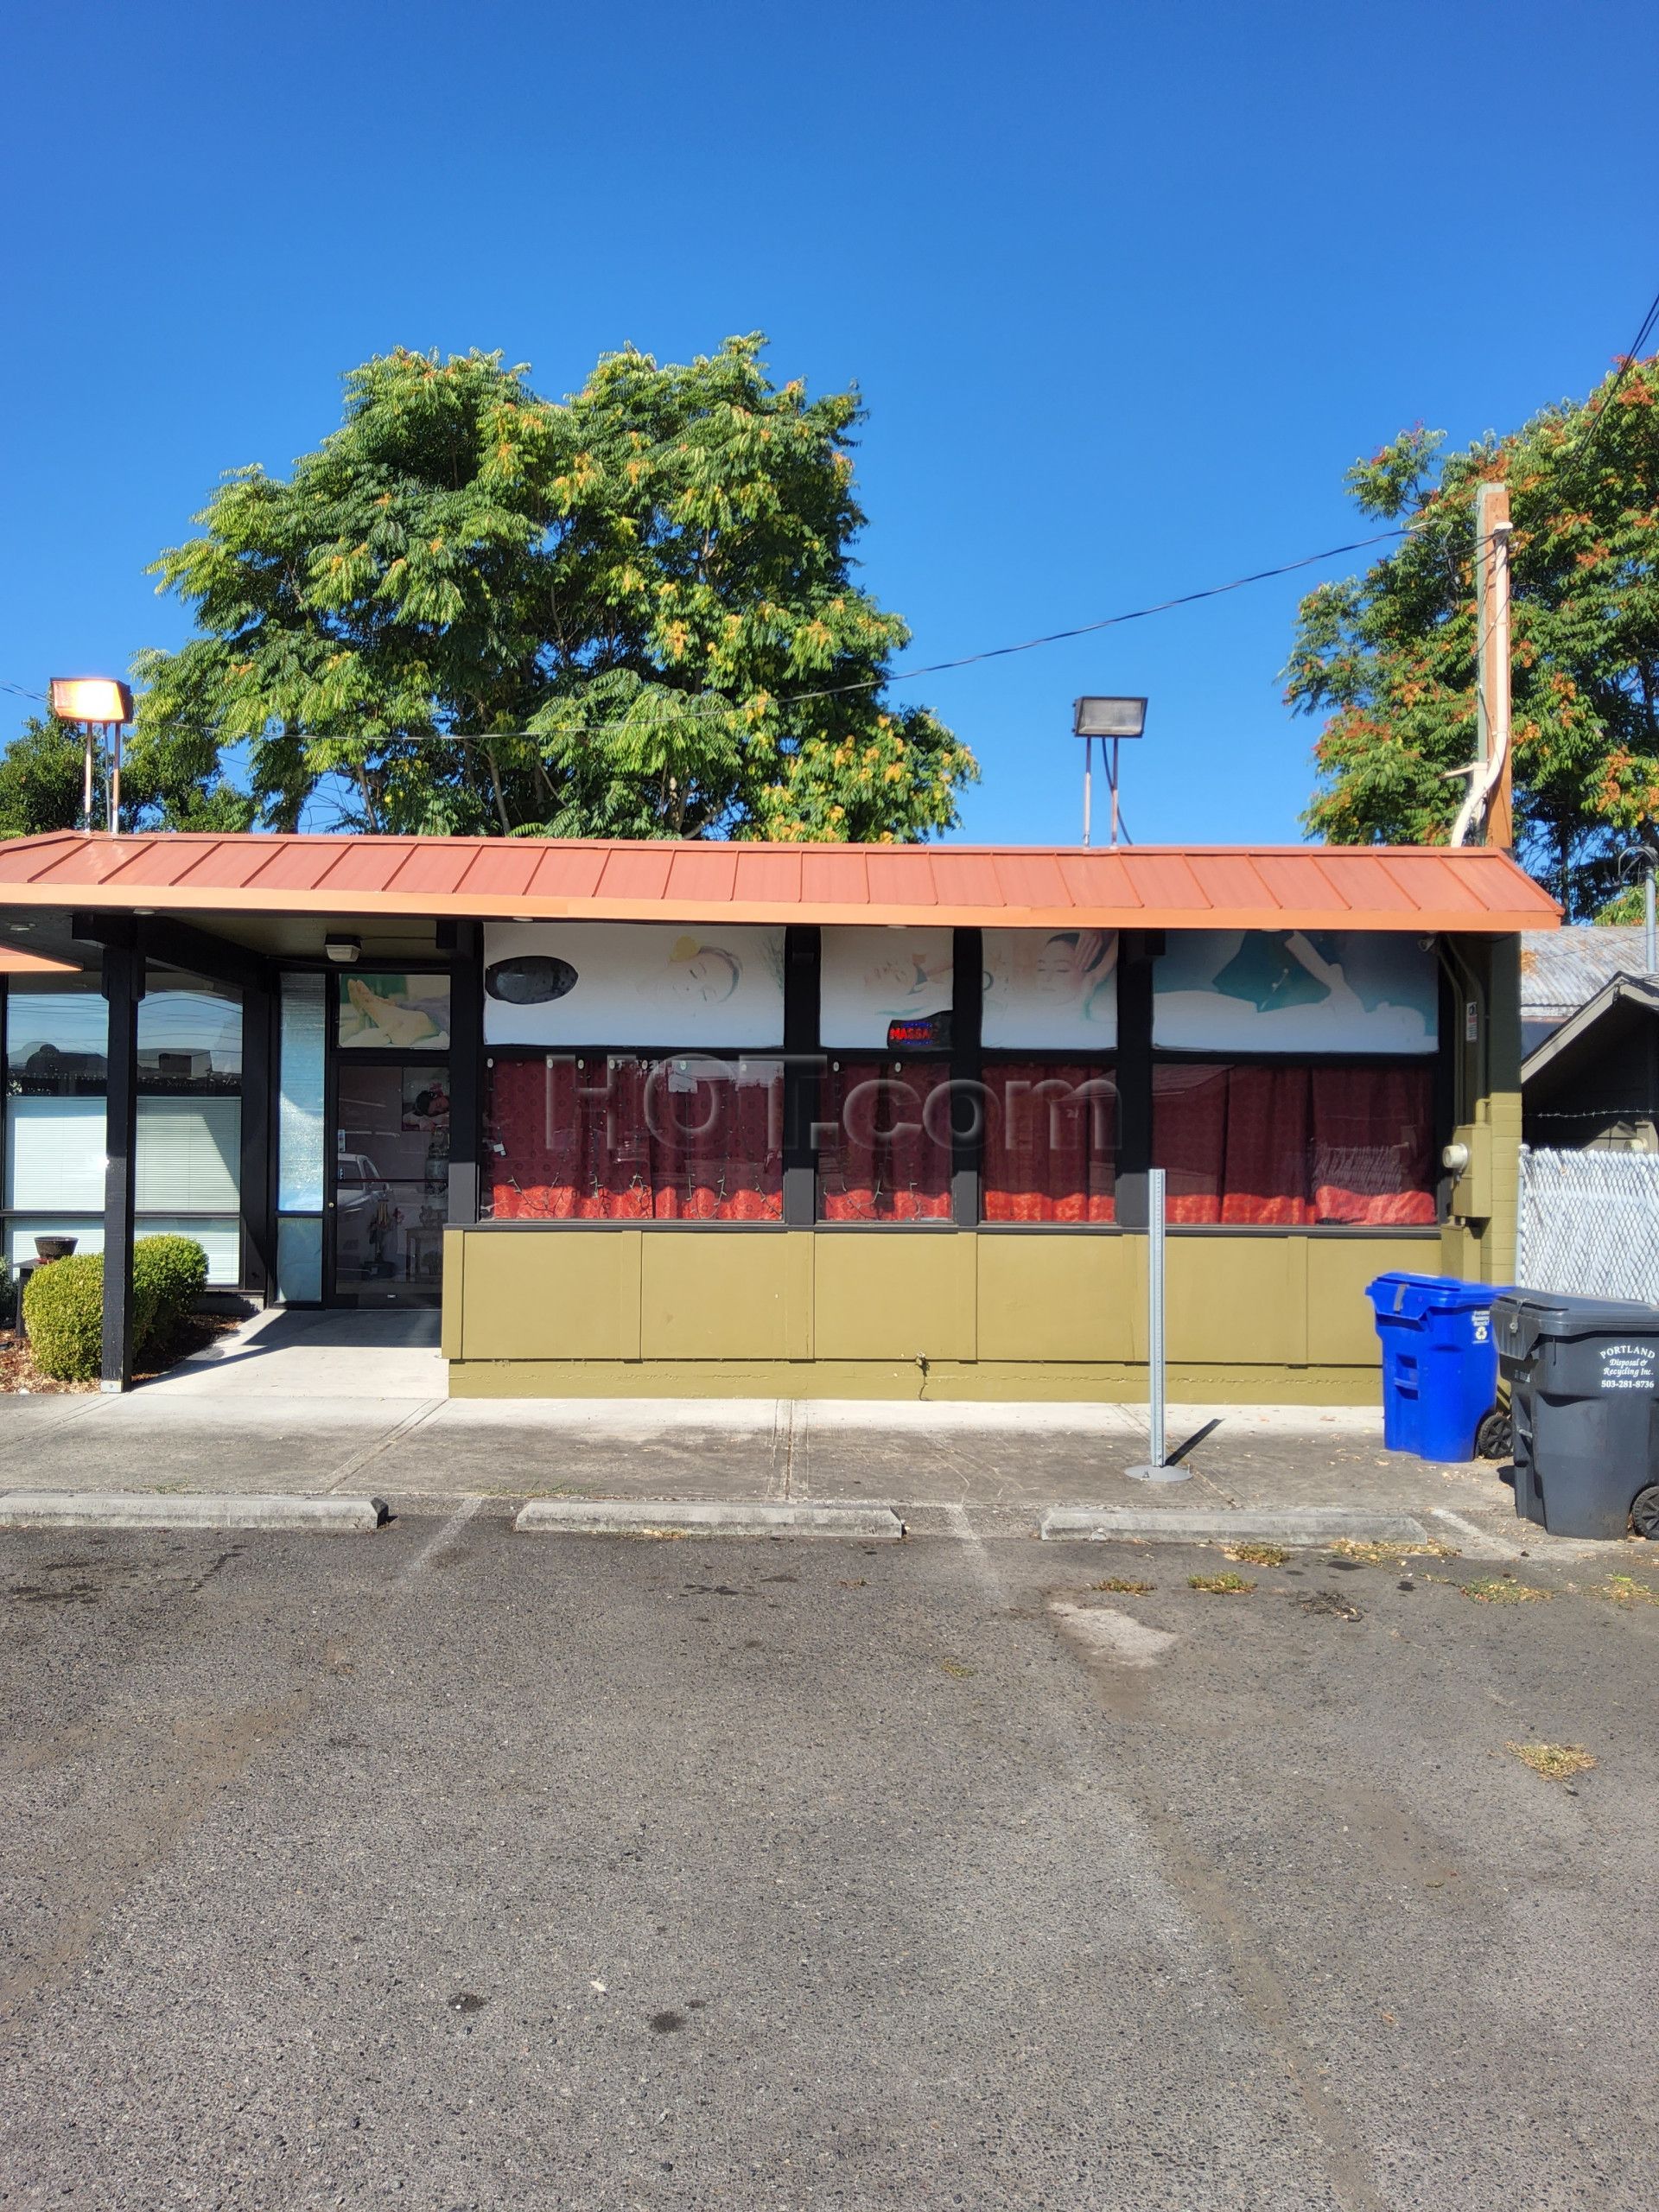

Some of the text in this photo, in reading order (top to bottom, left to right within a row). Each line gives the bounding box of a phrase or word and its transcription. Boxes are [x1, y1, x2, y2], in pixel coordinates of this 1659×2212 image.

[1599, 1344, 1656, 1359] PORTLAND
[1609, 1358, 1640, 1369] Disposal
[1603, 1367, 1640, 1377] Recycling
[1601, 1380, 1655, 1389] 503-281-8736
